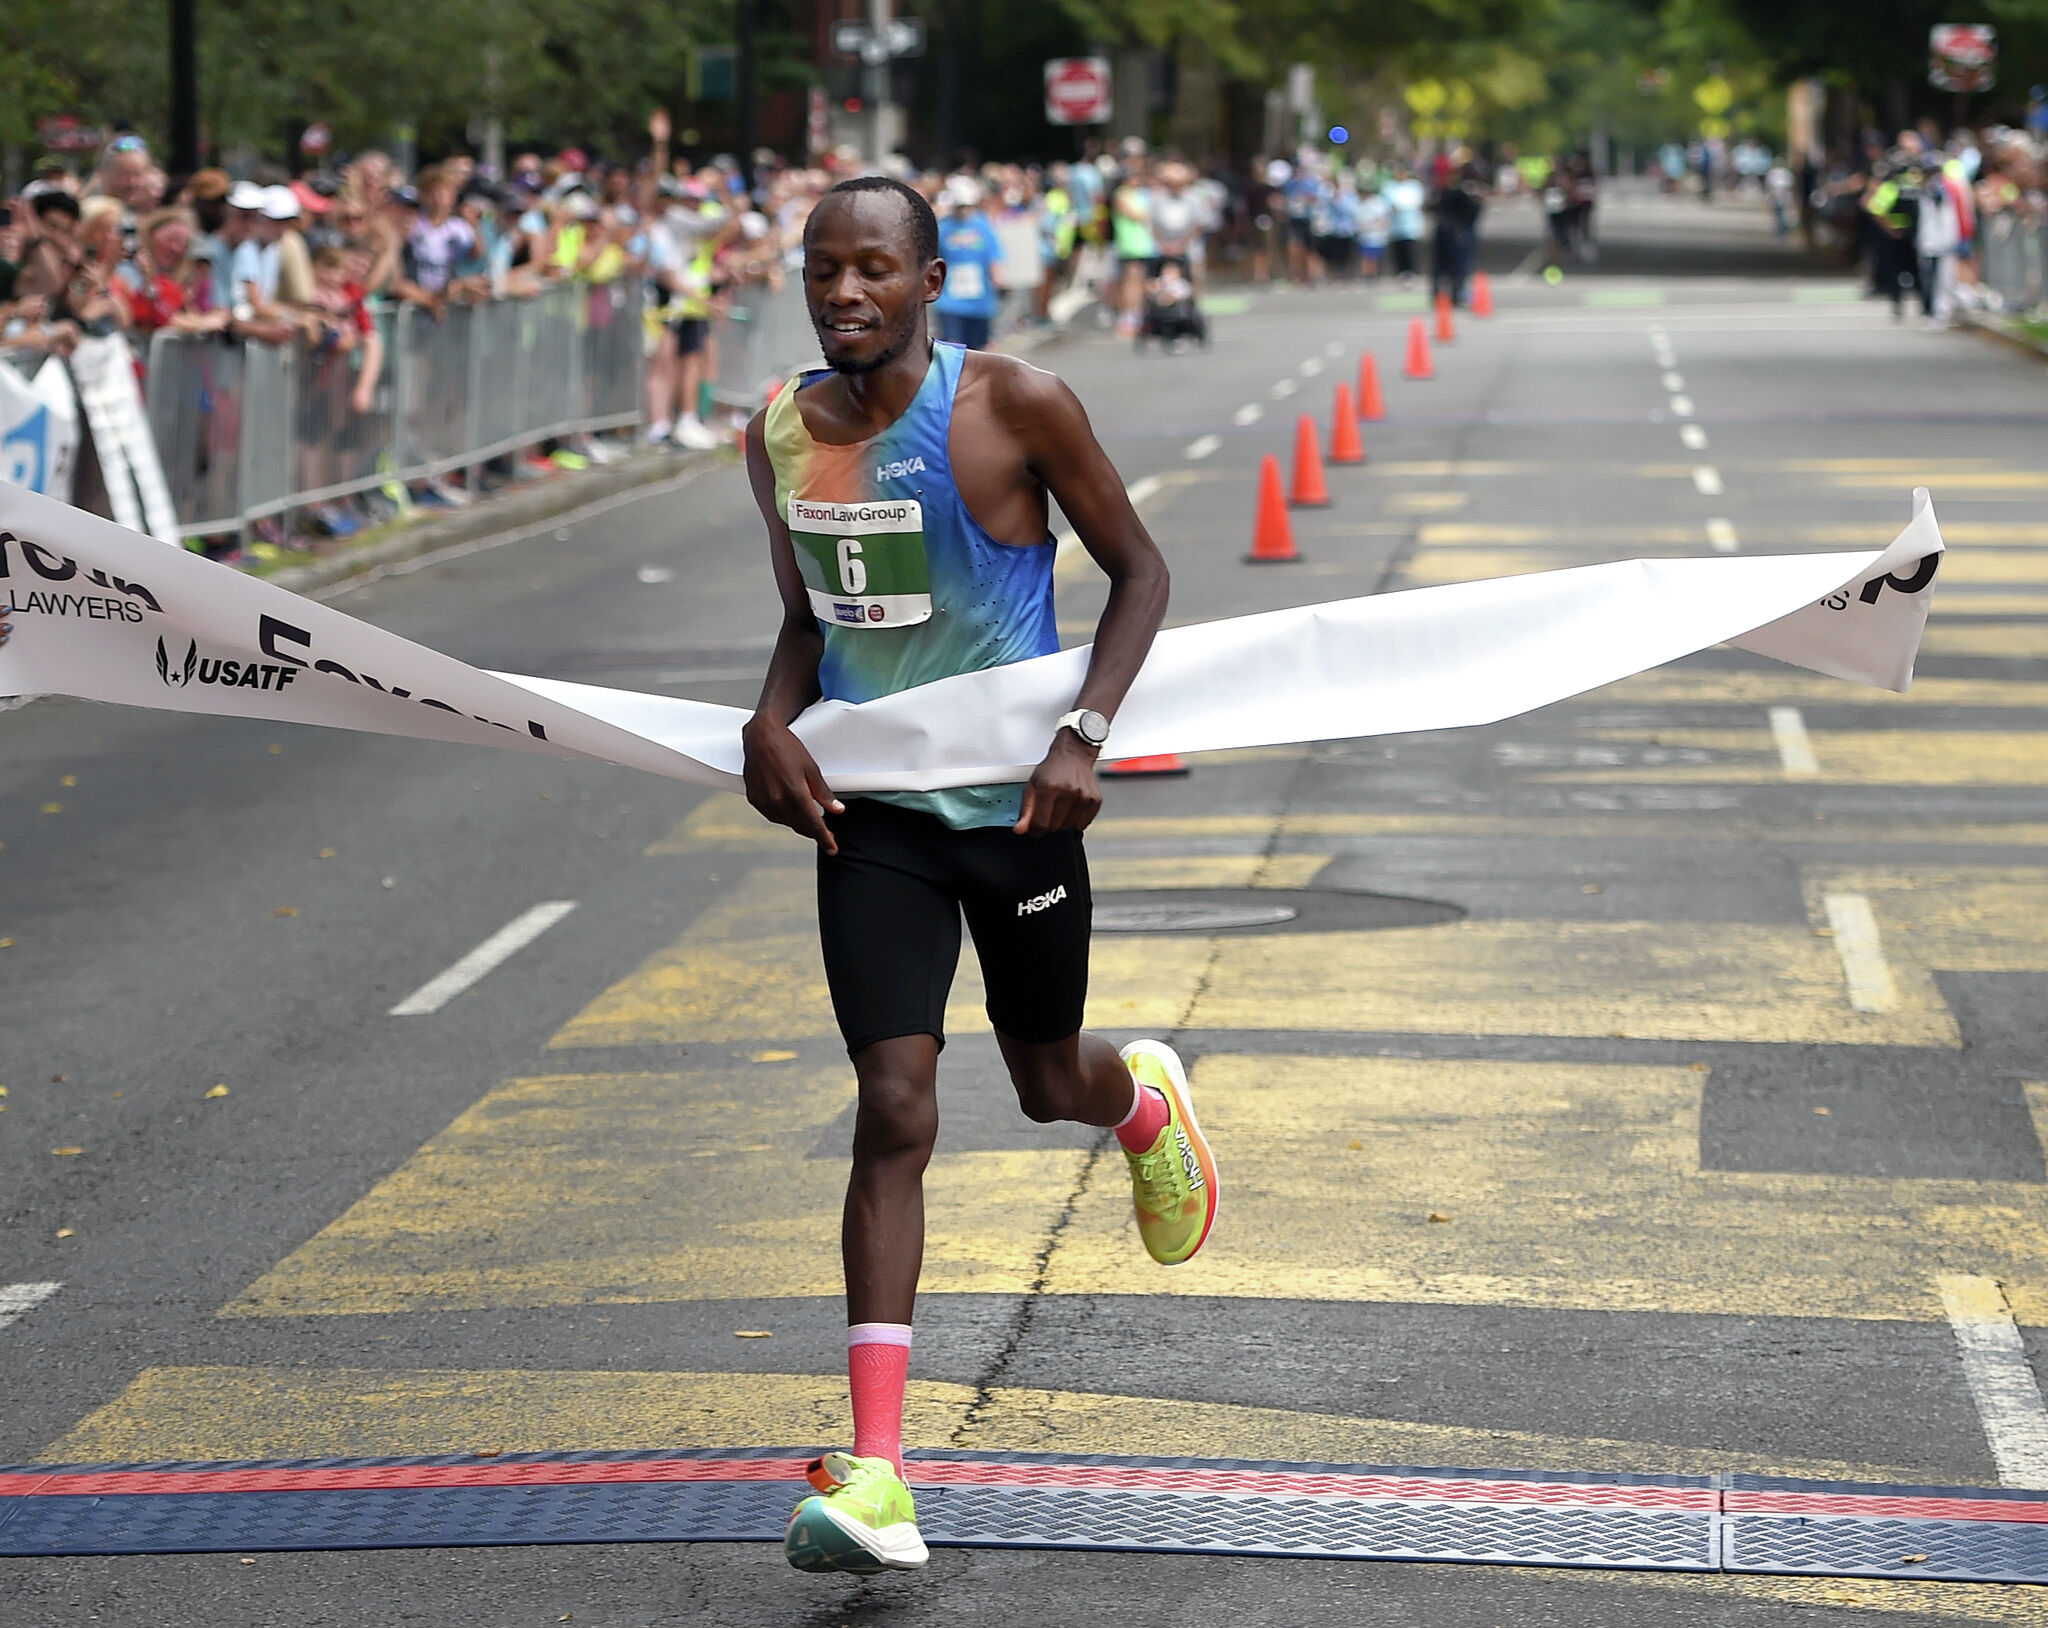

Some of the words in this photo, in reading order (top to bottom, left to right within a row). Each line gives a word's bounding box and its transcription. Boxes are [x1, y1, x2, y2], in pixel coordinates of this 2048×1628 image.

[877, 456, 926, 482] HOKA
[796, 504, 906, 522] FaxonLawGroup
[836, 538, 867, 594] 6
[10, 589, 143, 622] LAWYERS
[198, 658, 298, 692] USATF
[1017, 884, 1067, 916] HOKA
[1174, 1119, 1204, 1191] HOKA
